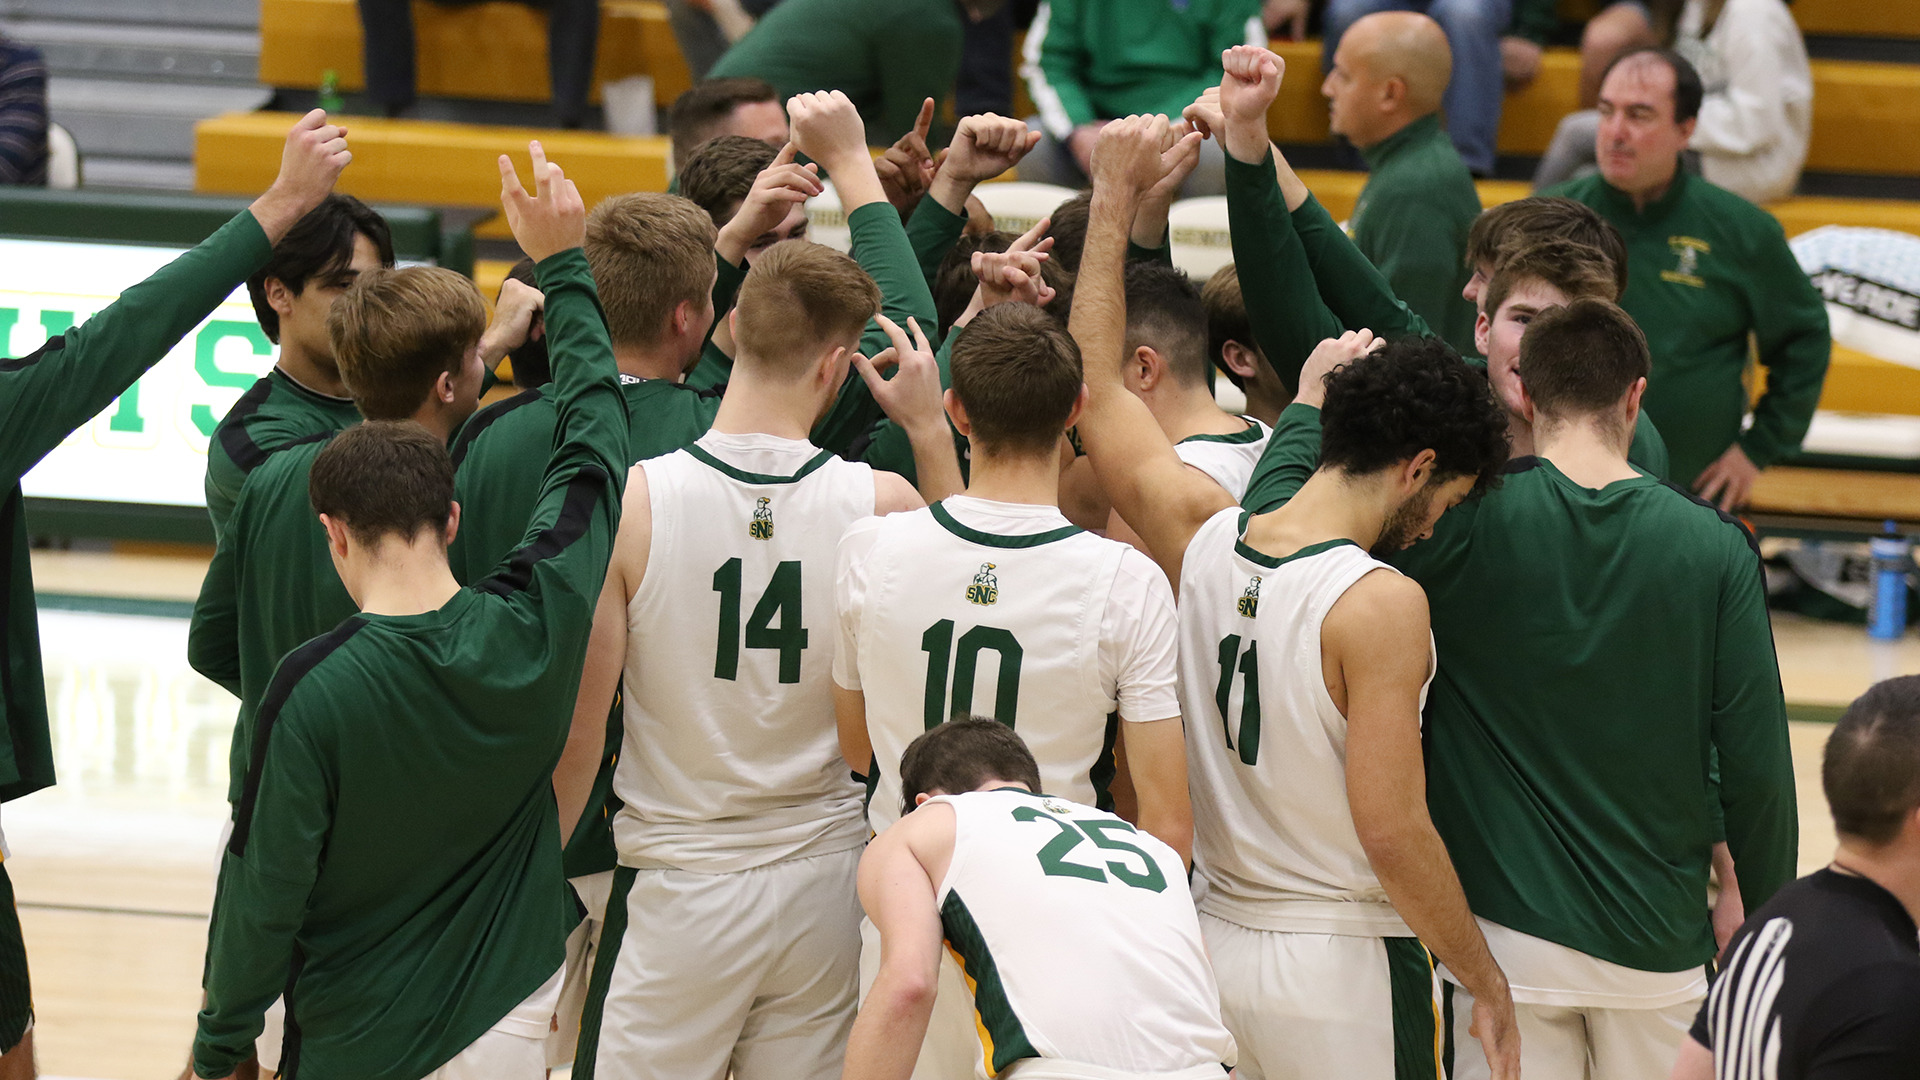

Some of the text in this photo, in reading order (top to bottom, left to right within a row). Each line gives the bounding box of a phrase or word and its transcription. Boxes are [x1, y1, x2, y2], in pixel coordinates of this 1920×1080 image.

[750, 520, 774, 540] SNC
[713, 557, 808, 683] 14
[966, 584, 998, 606] SNC
[1237, 597, 1258, 619] SN
[921, 618, 1023, 731] 10
[1215, 634, 1261, 766] 11
[1011, 806, 1168, 893] 25
